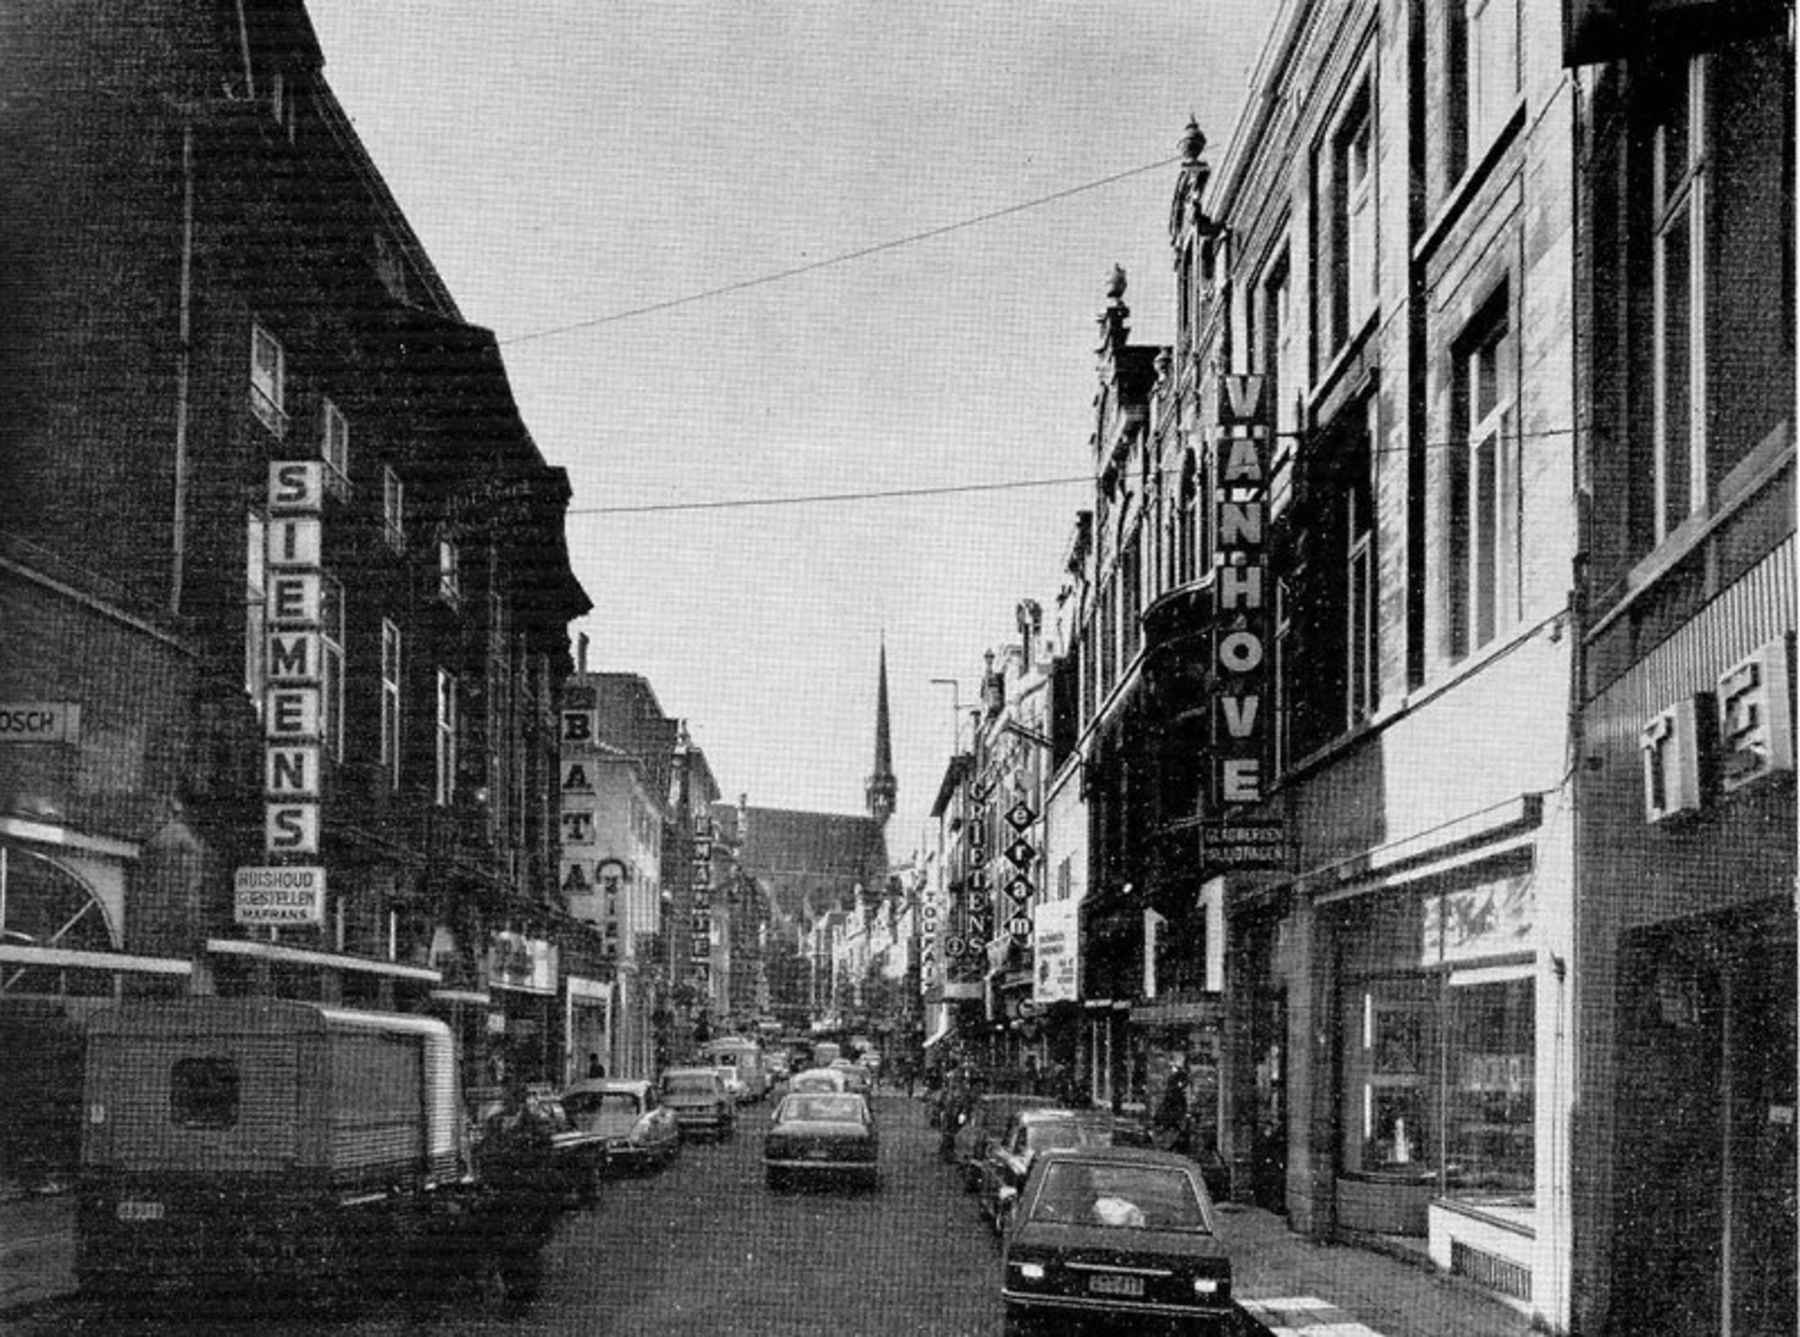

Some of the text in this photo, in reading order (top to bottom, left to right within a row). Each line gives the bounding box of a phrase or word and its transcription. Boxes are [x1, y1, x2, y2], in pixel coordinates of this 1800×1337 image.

[273, 466, 308, 846] SIEMENS
[1219, 377, 1263, 801] VANHOVE
[238, 871, 314, 888] HUISHOUD
[562, 713, 593, 892] BATA
[1010, 808, 1030, 935] eram
